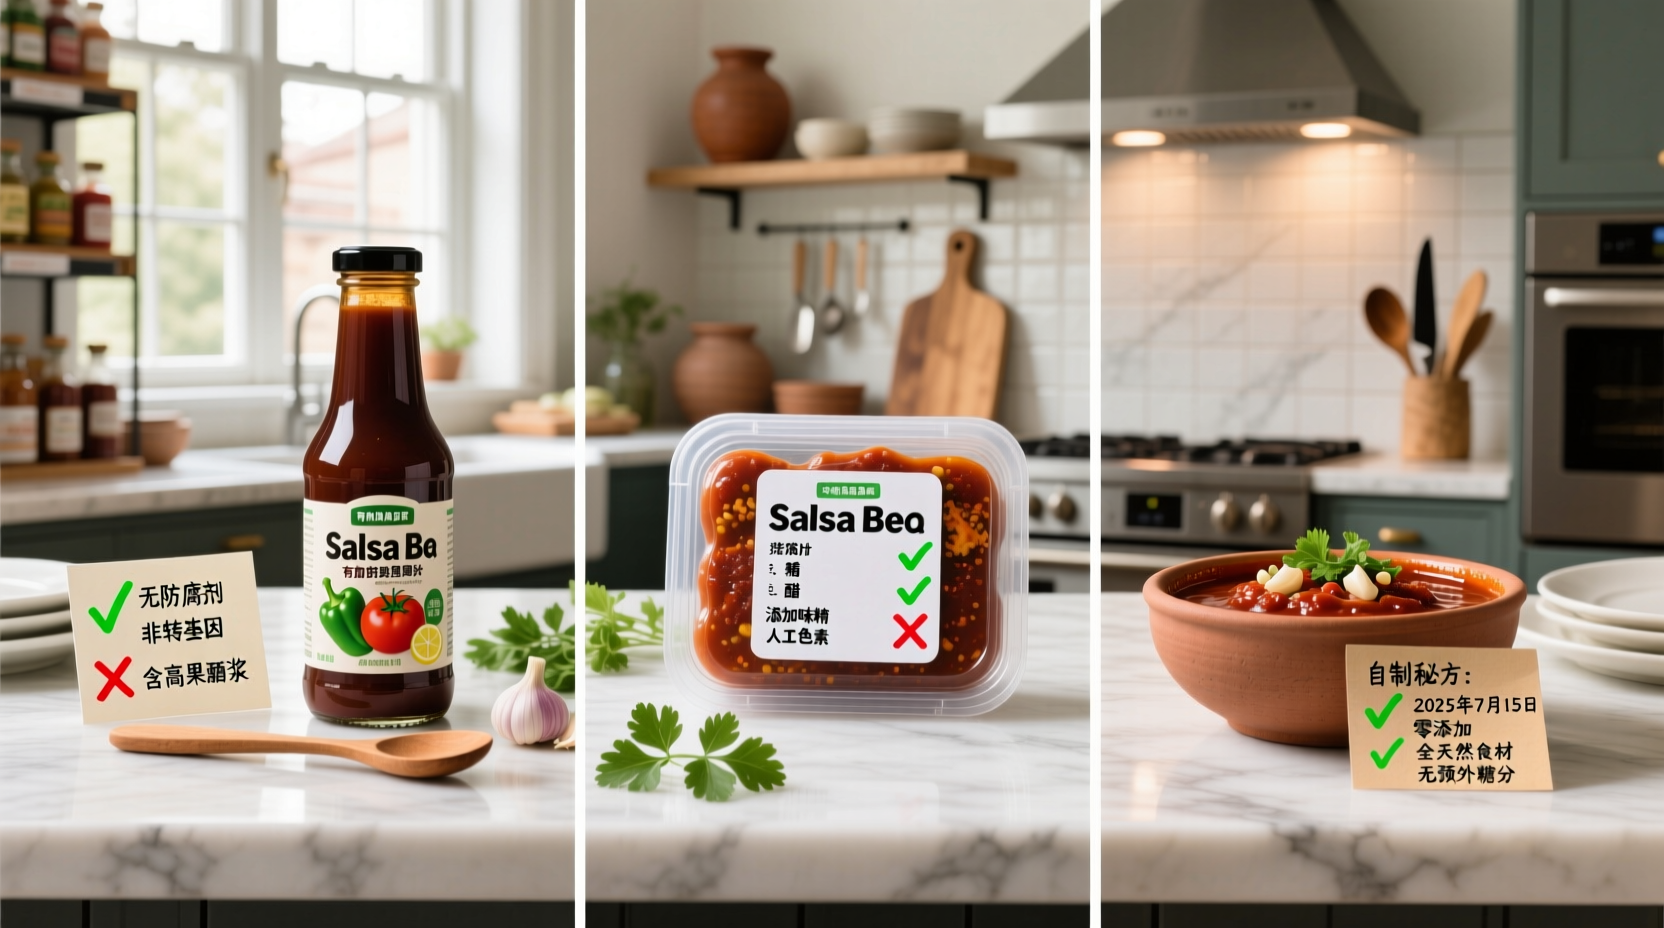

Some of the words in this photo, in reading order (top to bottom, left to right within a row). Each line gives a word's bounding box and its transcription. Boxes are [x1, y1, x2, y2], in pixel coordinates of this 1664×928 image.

[769, 503, 855, 532] Salsa
[325, 531, 399, 561] Salsa
[766, 627, 829, 646] 人工色素
[1413, 695, 1537, 715] 2025年7月15日
[1416, 741, 1513, 761] 全天然食材
